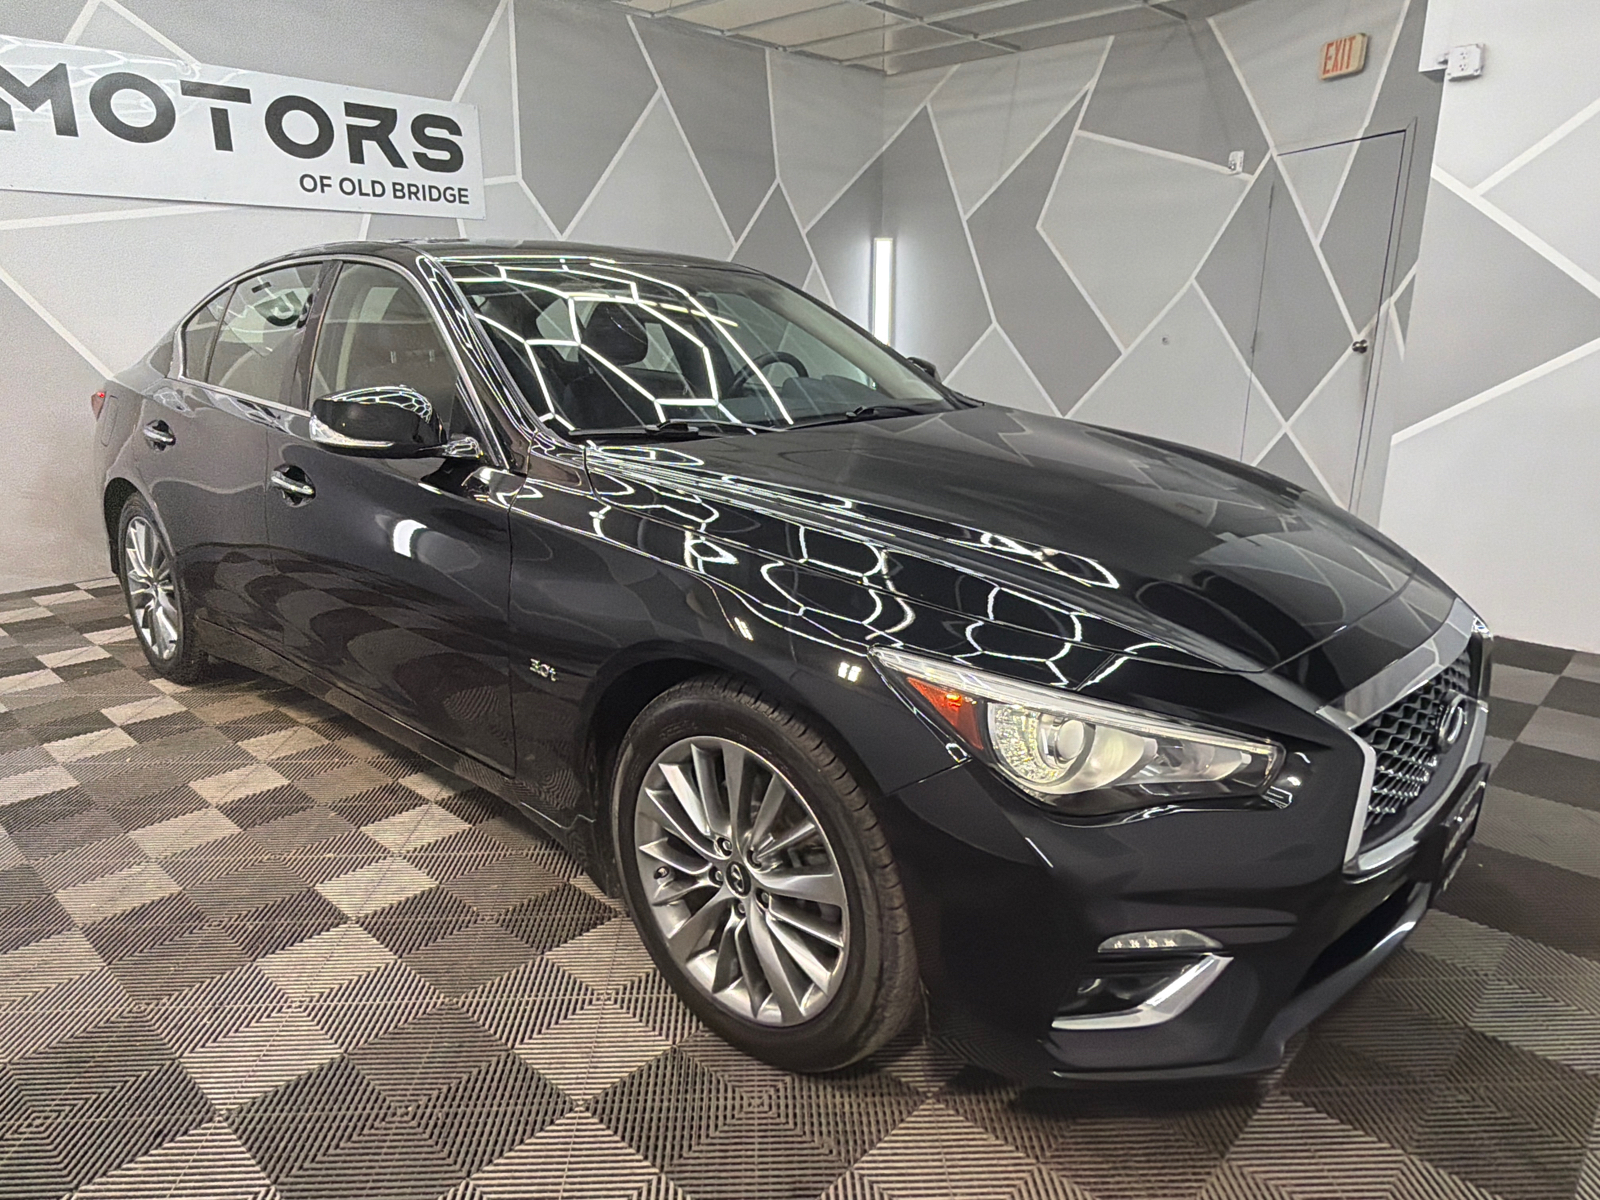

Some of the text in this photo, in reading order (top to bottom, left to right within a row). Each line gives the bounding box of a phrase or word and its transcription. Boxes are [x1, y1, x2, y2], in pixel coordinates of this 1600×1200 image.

[1323, 36, 1356, 74] EXIT
[0, 62, 464, 173] MOTORS
[299, 173, 470, 205] OF OLD BRIDGE
